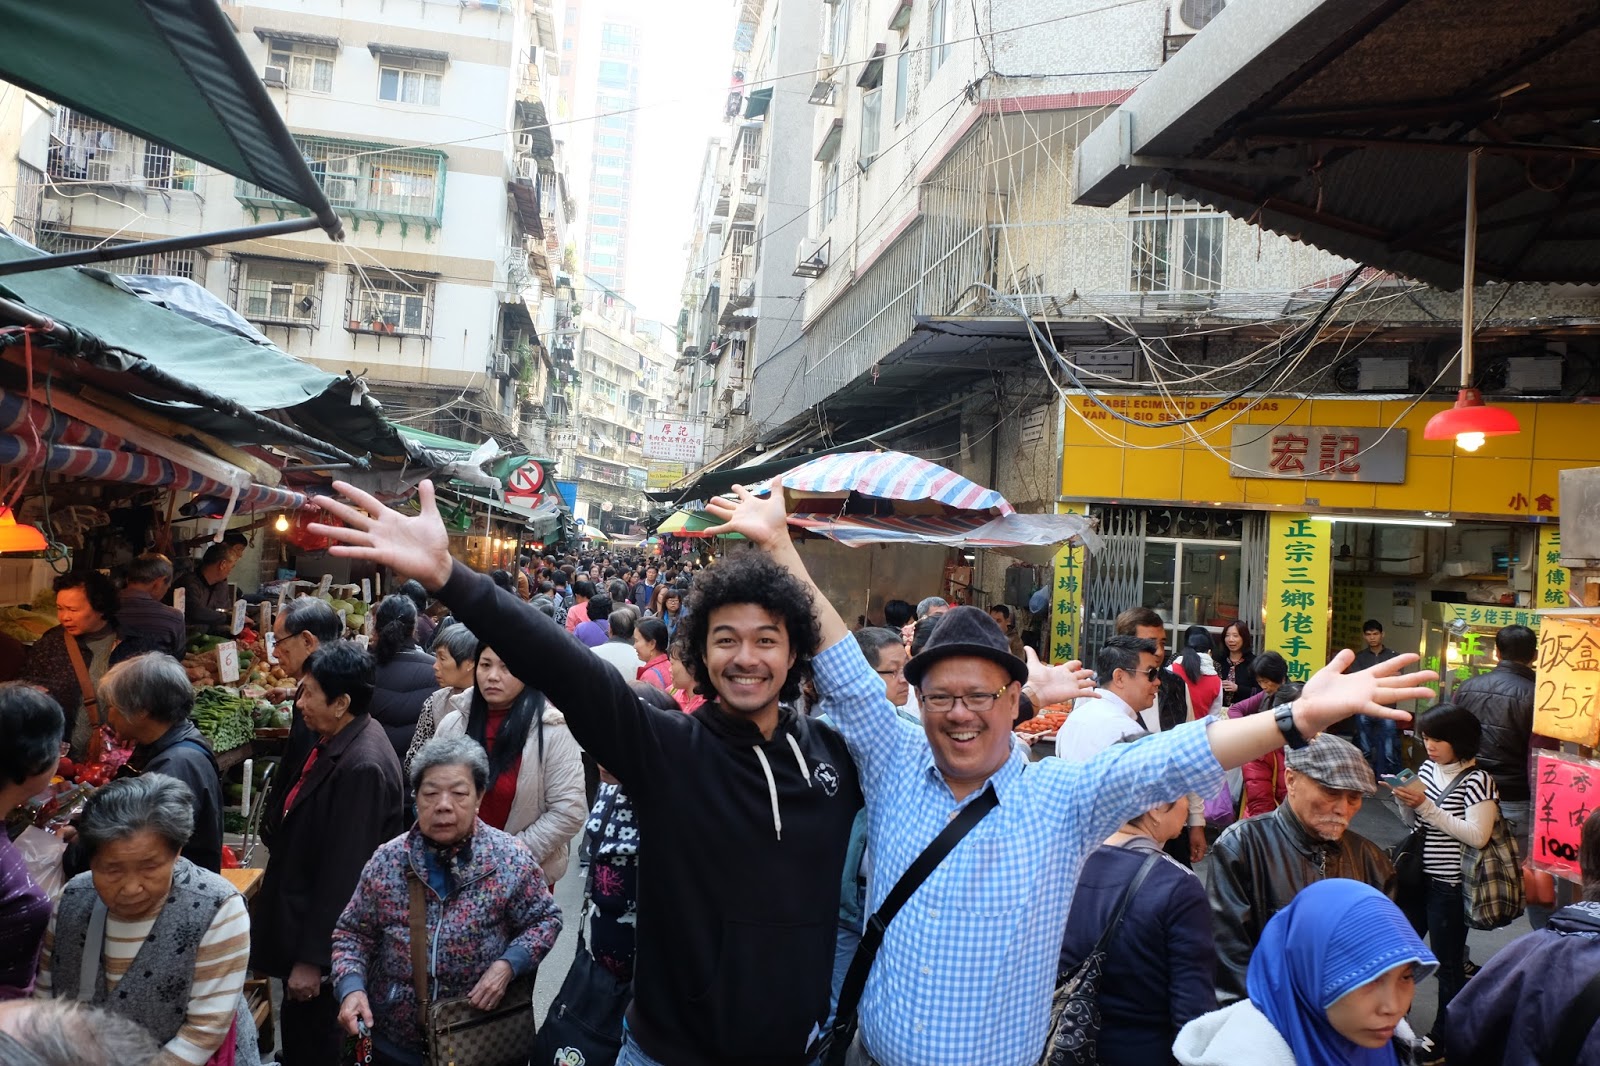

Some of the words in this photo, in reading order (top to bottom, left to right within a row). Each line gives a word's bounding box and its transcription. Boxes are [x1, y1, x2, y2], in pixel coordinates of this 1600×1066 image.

[1200, 401, 1215, 410] DE
[1221, 401, 1279, 411] COMDAS
[1083, 411, 1106, 420] VAN
[1134, 412, 1153, 421] SIO
[1270, 433, 1361, 475] 宏記
[1508, 492, 1555, 512] 小食
[225, 652, 232, 666] 6
[1539, 628, 1600, 674] 饭盒
